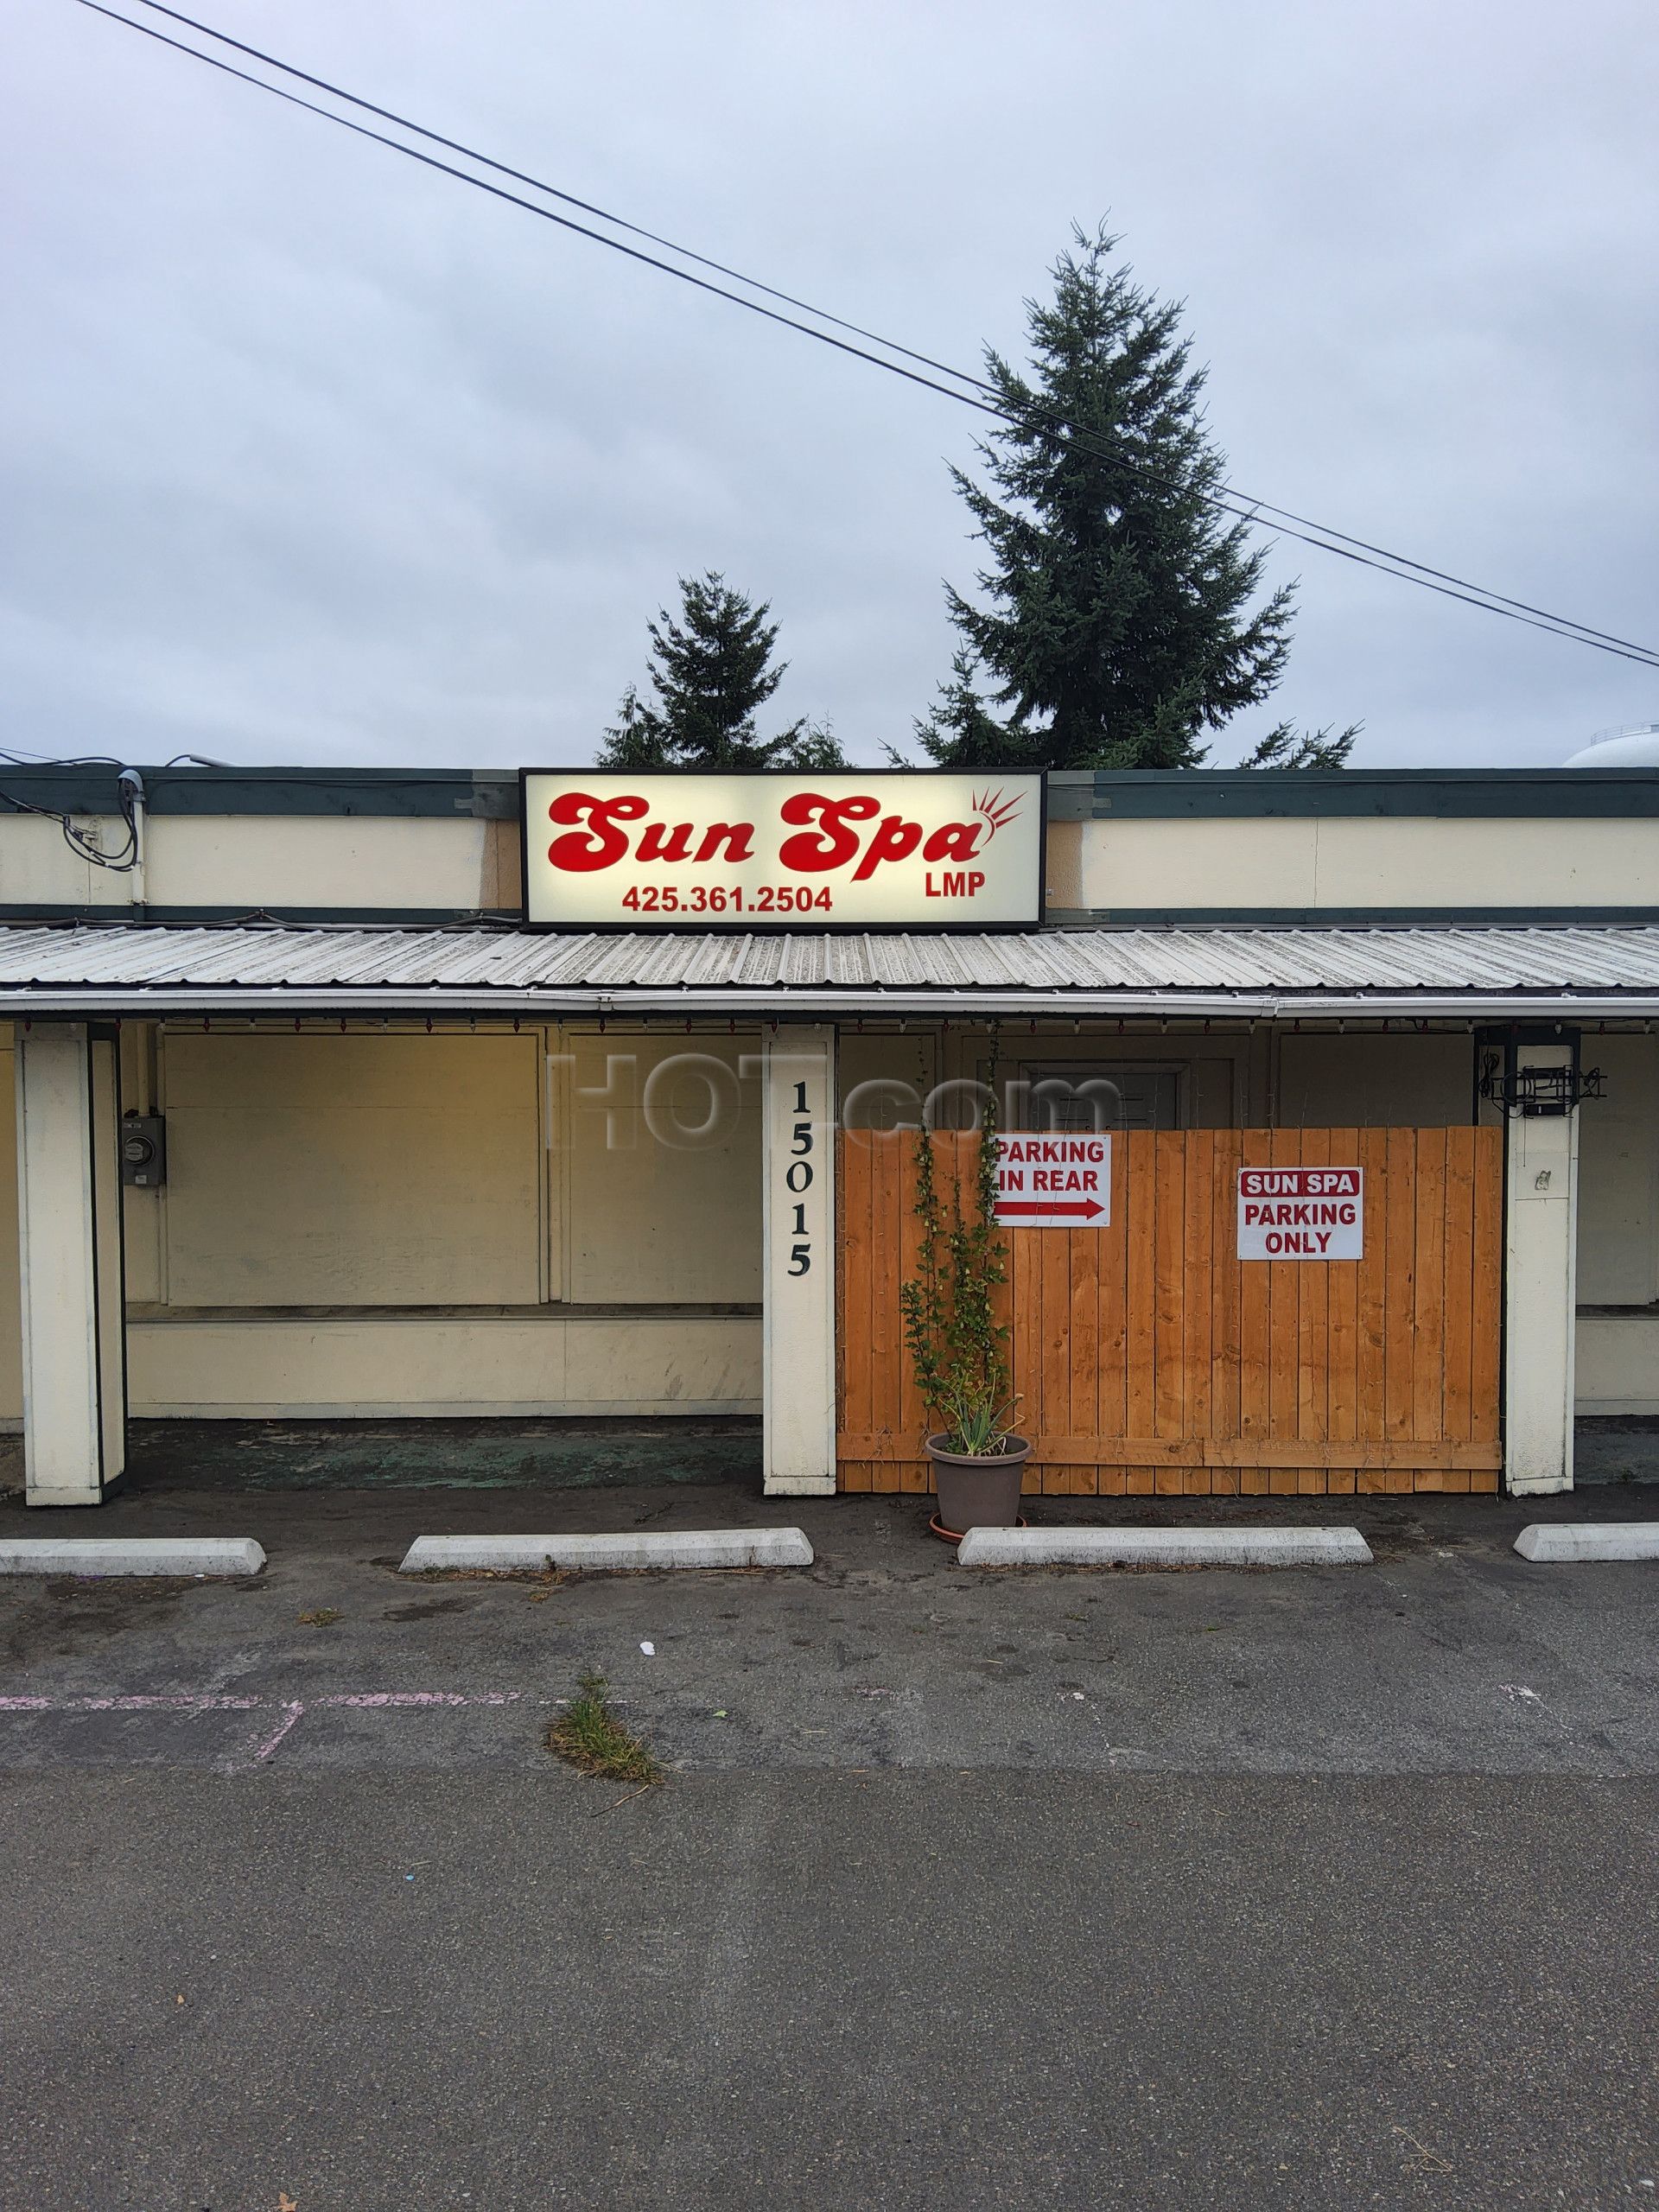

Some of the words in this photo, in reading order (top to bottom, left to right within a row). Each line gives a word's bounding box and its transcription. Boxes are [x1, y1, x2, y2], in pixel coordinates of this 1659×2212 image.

[548, 791, 755, 873] Sun
[779, 792, 983, 883] Spa
[925, 872, 986, 898] LMP
[621, 887, 833, 912] 425.361.2504
[996, 1141, 1104, 1163] PARKING
[999, 1170, 1024, 1192] IN
[1033, 1170, 1098, 1192] REAR
[1246, 1173, 1299, 1194] SUN
[1306, 1173, 1355, 1193] SPA
[1244, 1203, 1357, 1226] PARKING
[1265, 1231, 1332, 1253] ONLY
